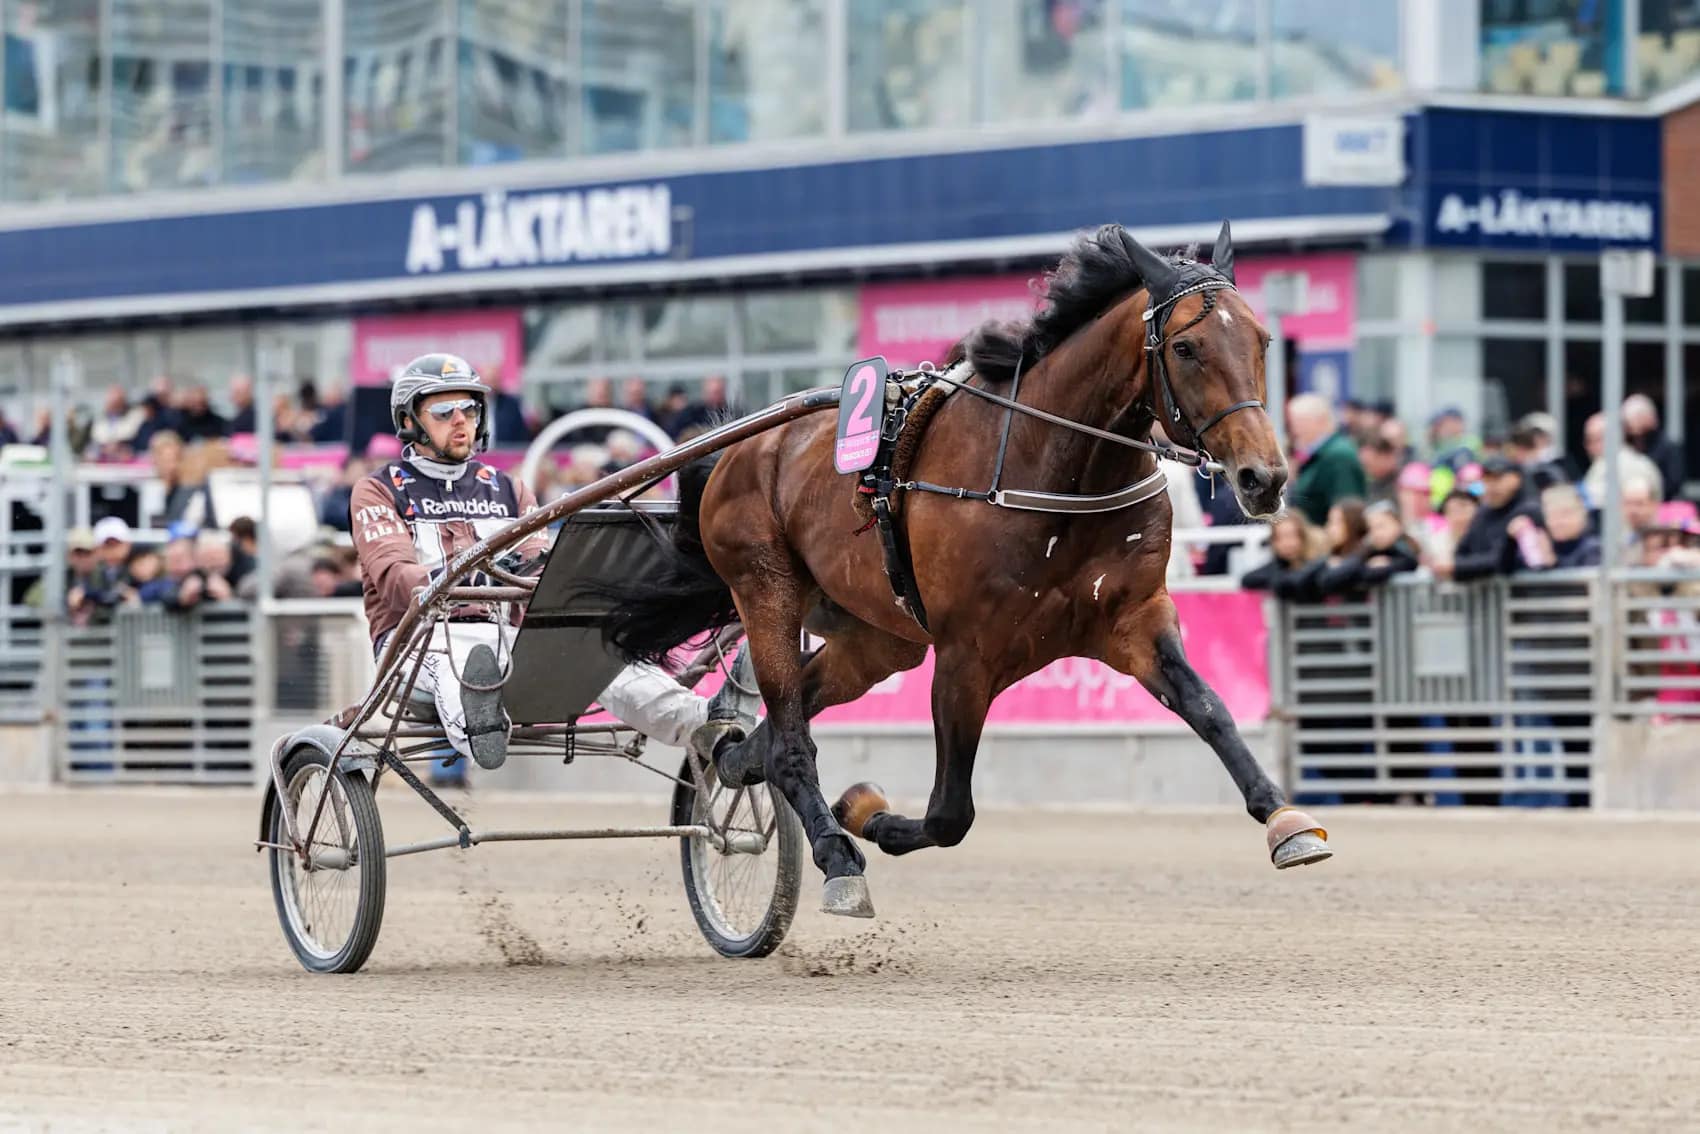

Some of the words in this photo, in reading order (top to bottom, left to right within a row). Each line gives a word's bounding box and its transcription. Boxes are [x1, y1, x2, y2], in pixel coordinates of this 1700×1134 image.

[406, 185, 671, 273] A-LÄKTAREN
[1438, 190, 1653, 239] A-LÄKTAREN
[845, 365, 877, 438] 2
[421, 498, 509, 517] Ramudden
